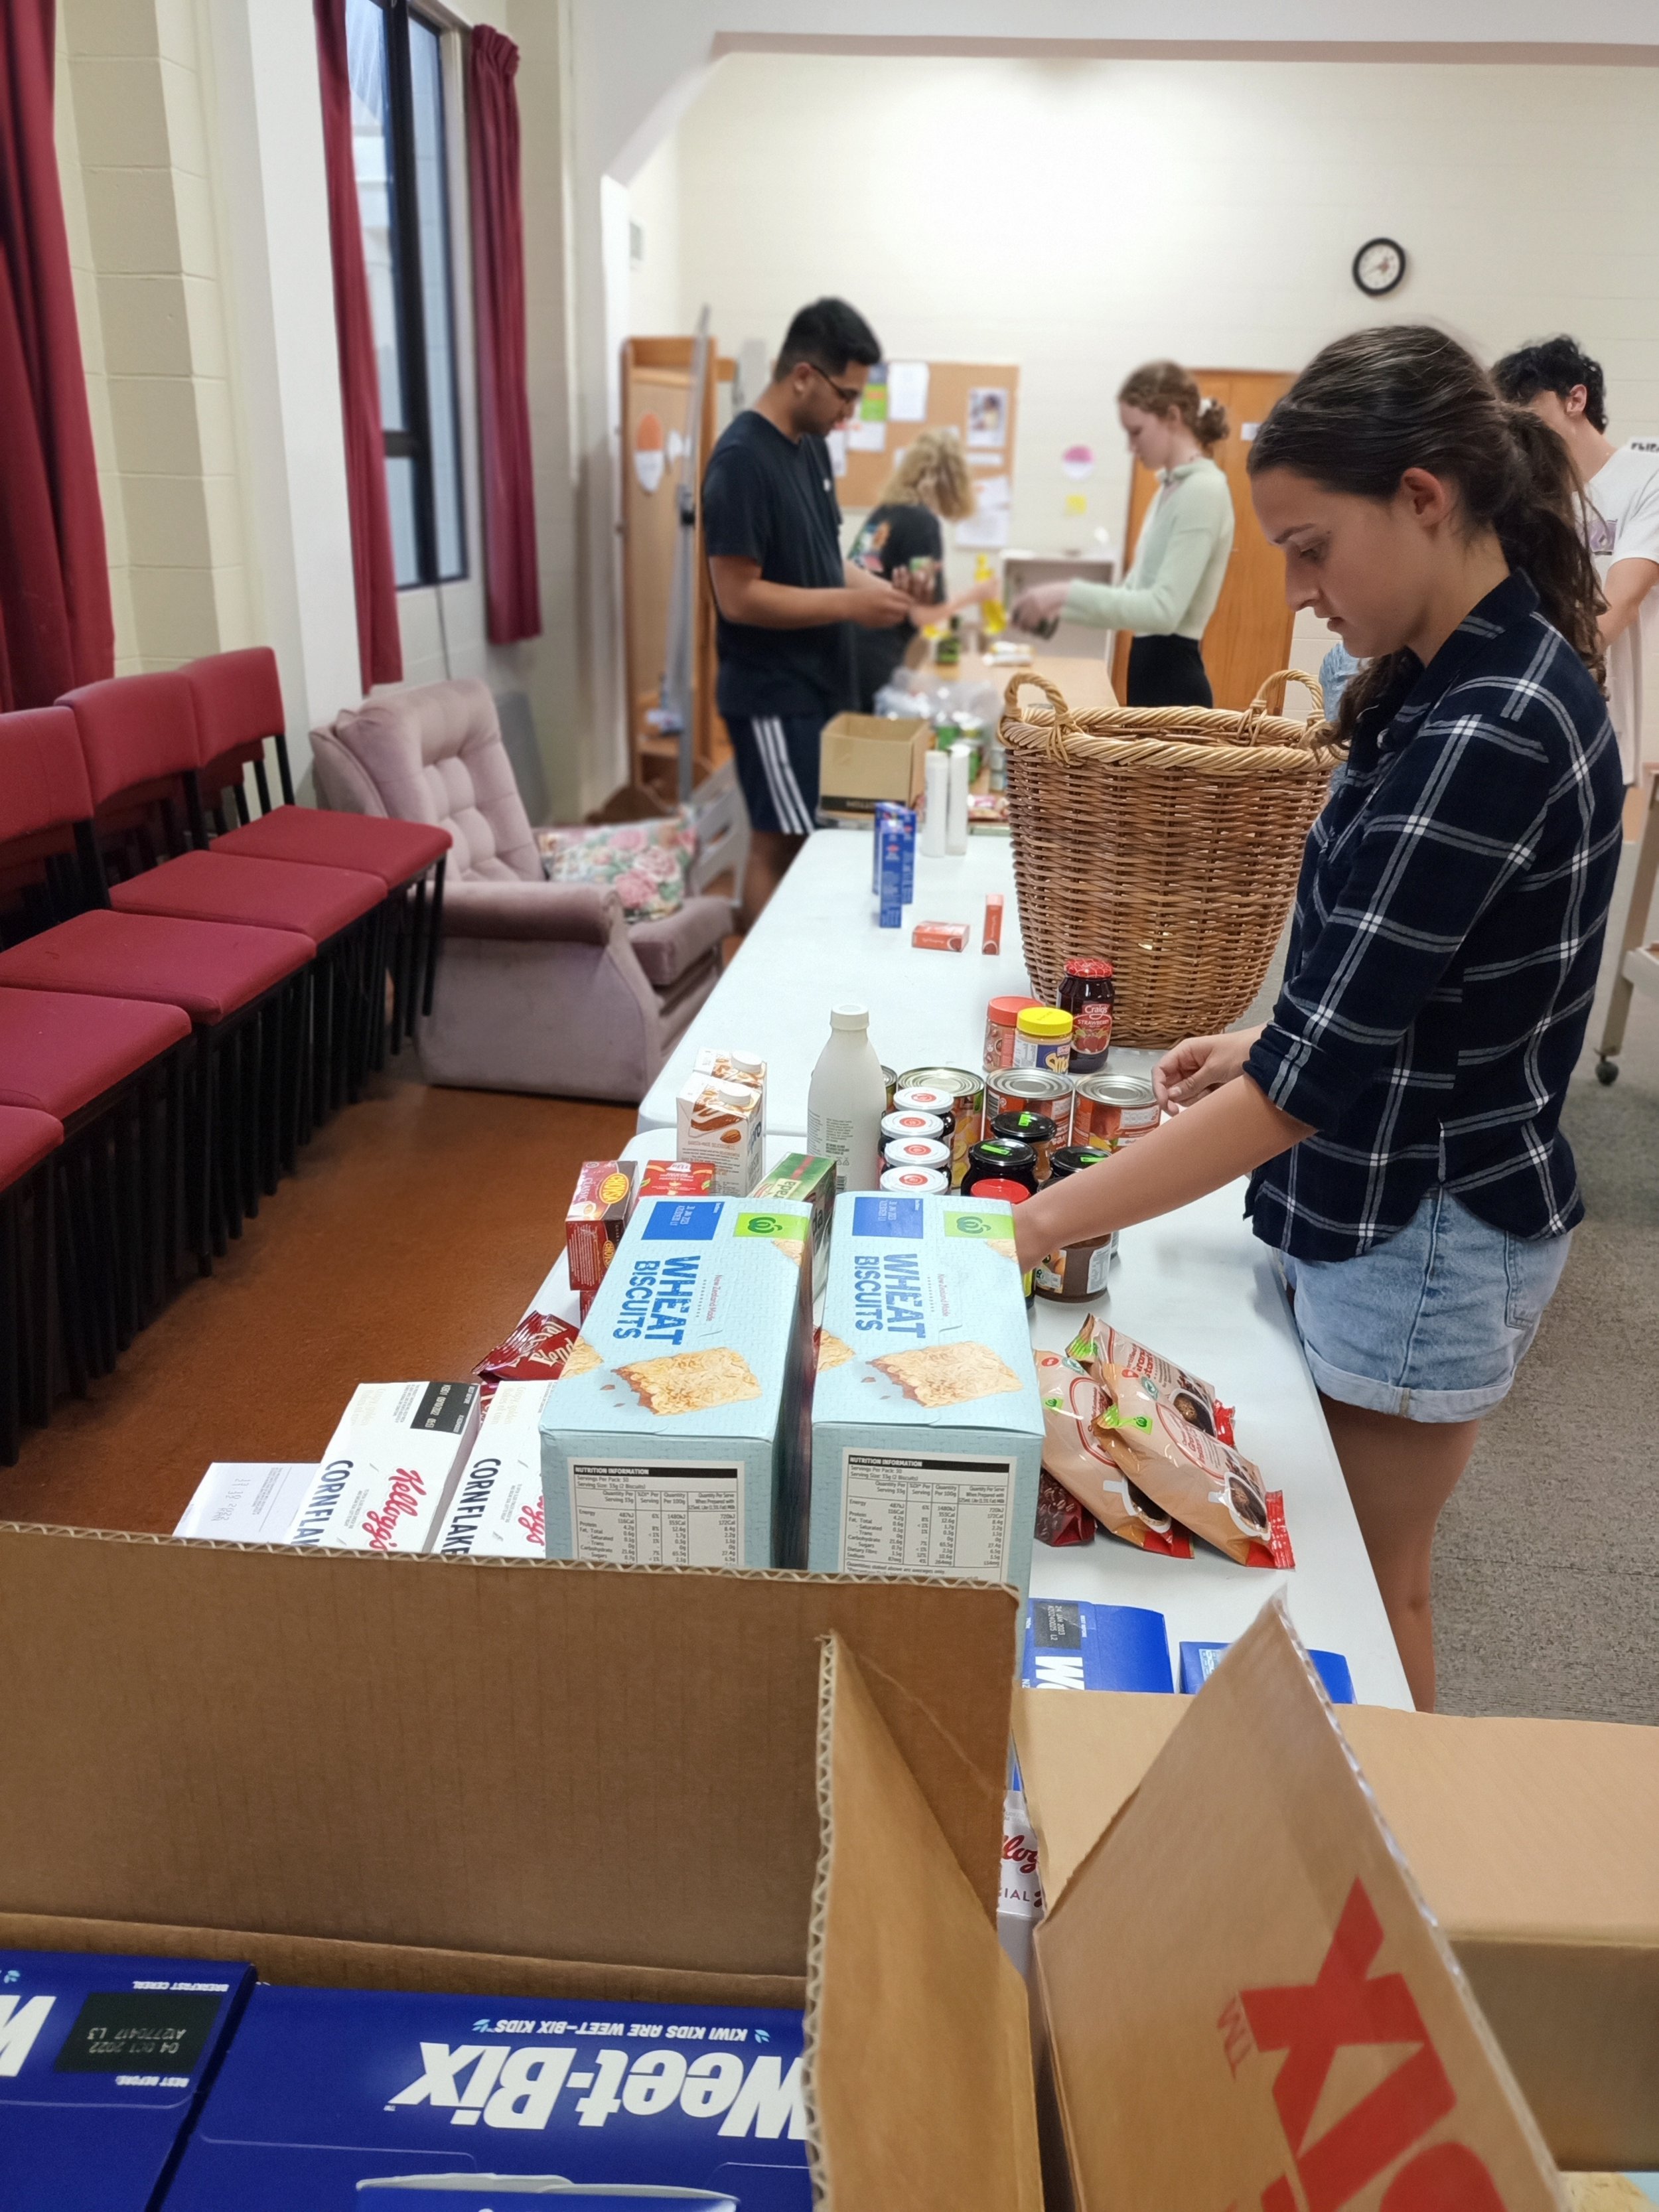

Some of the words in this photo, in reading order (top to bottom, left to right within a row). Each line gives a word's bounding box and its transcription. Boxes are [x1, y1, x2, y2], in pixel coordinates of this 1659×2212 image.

[576, 1177, 593, 1202] CLASSIC
[601, 1174, 627, 1203] CHOYSA
[613, 1261, 660, 1340] BISCUITS
[644, 1255, 701, 1345] WHEAT
[854, 1255, 885, 1333] BISCUITS
[883, 1254, 926, 1338] WHEAT
[528, 1337, 575, 1368] Blend
[362, 1467, 427, 1552] Kellogg's
[494, 2019, 536, 2034] KIDS
[538, 2020, 624, 2037] WEET-BIX
[628, 2023, 663, 2038] ARE
[666, 2024, 707, 2039] KIDS
[711, 2027, 748, 2041] KIWI
[88, 2041, 123, 2054] 2022
[115, 2075, 159, 2087] BEFORE
[159, 2077, 189, 2088] BEST
[388, 2041, 809, 2140] Weet-Bix
